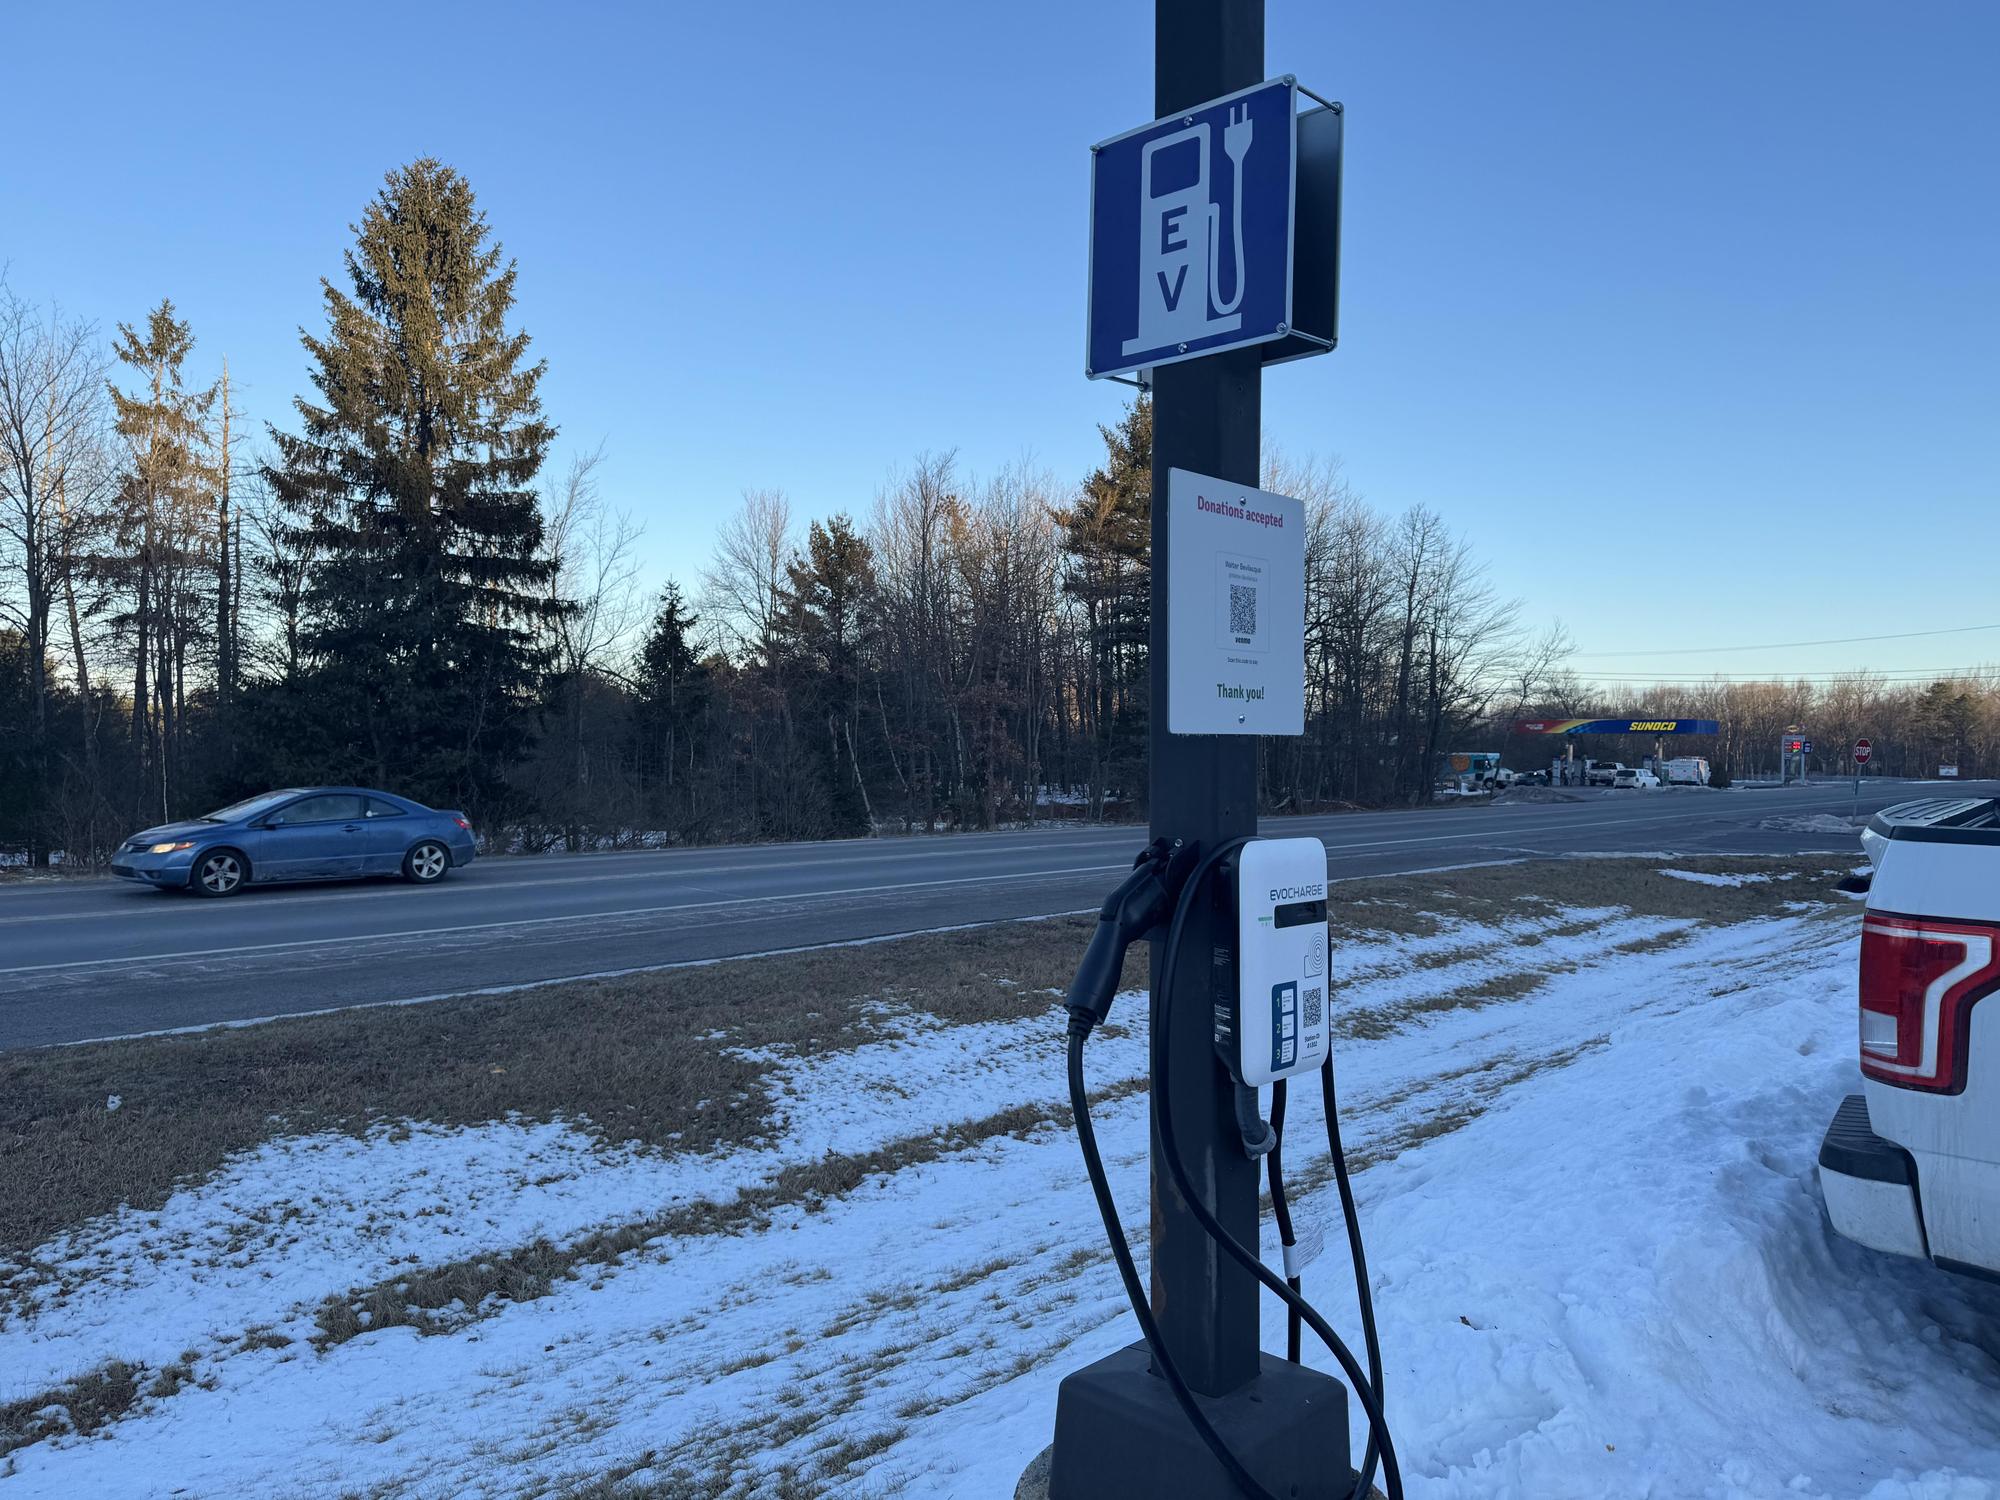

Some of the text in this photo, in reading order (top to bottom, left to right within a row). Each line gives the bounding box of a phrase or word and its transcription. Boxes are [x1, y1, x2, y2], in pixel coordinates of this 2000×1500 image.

[1197, 495, 1284, 528] Donations accepted
[1217, 683, 1265, 702] Thank you!
[1629, 721, 1677, 731] SUNOCO
[1855, 746, 1872, 757] STOP
[1270, 884, 1323, 901] EVOCHARGE
[1276, 1023, 1281, 1034] 2
[1276, 1049, 1281, 1059] 3
